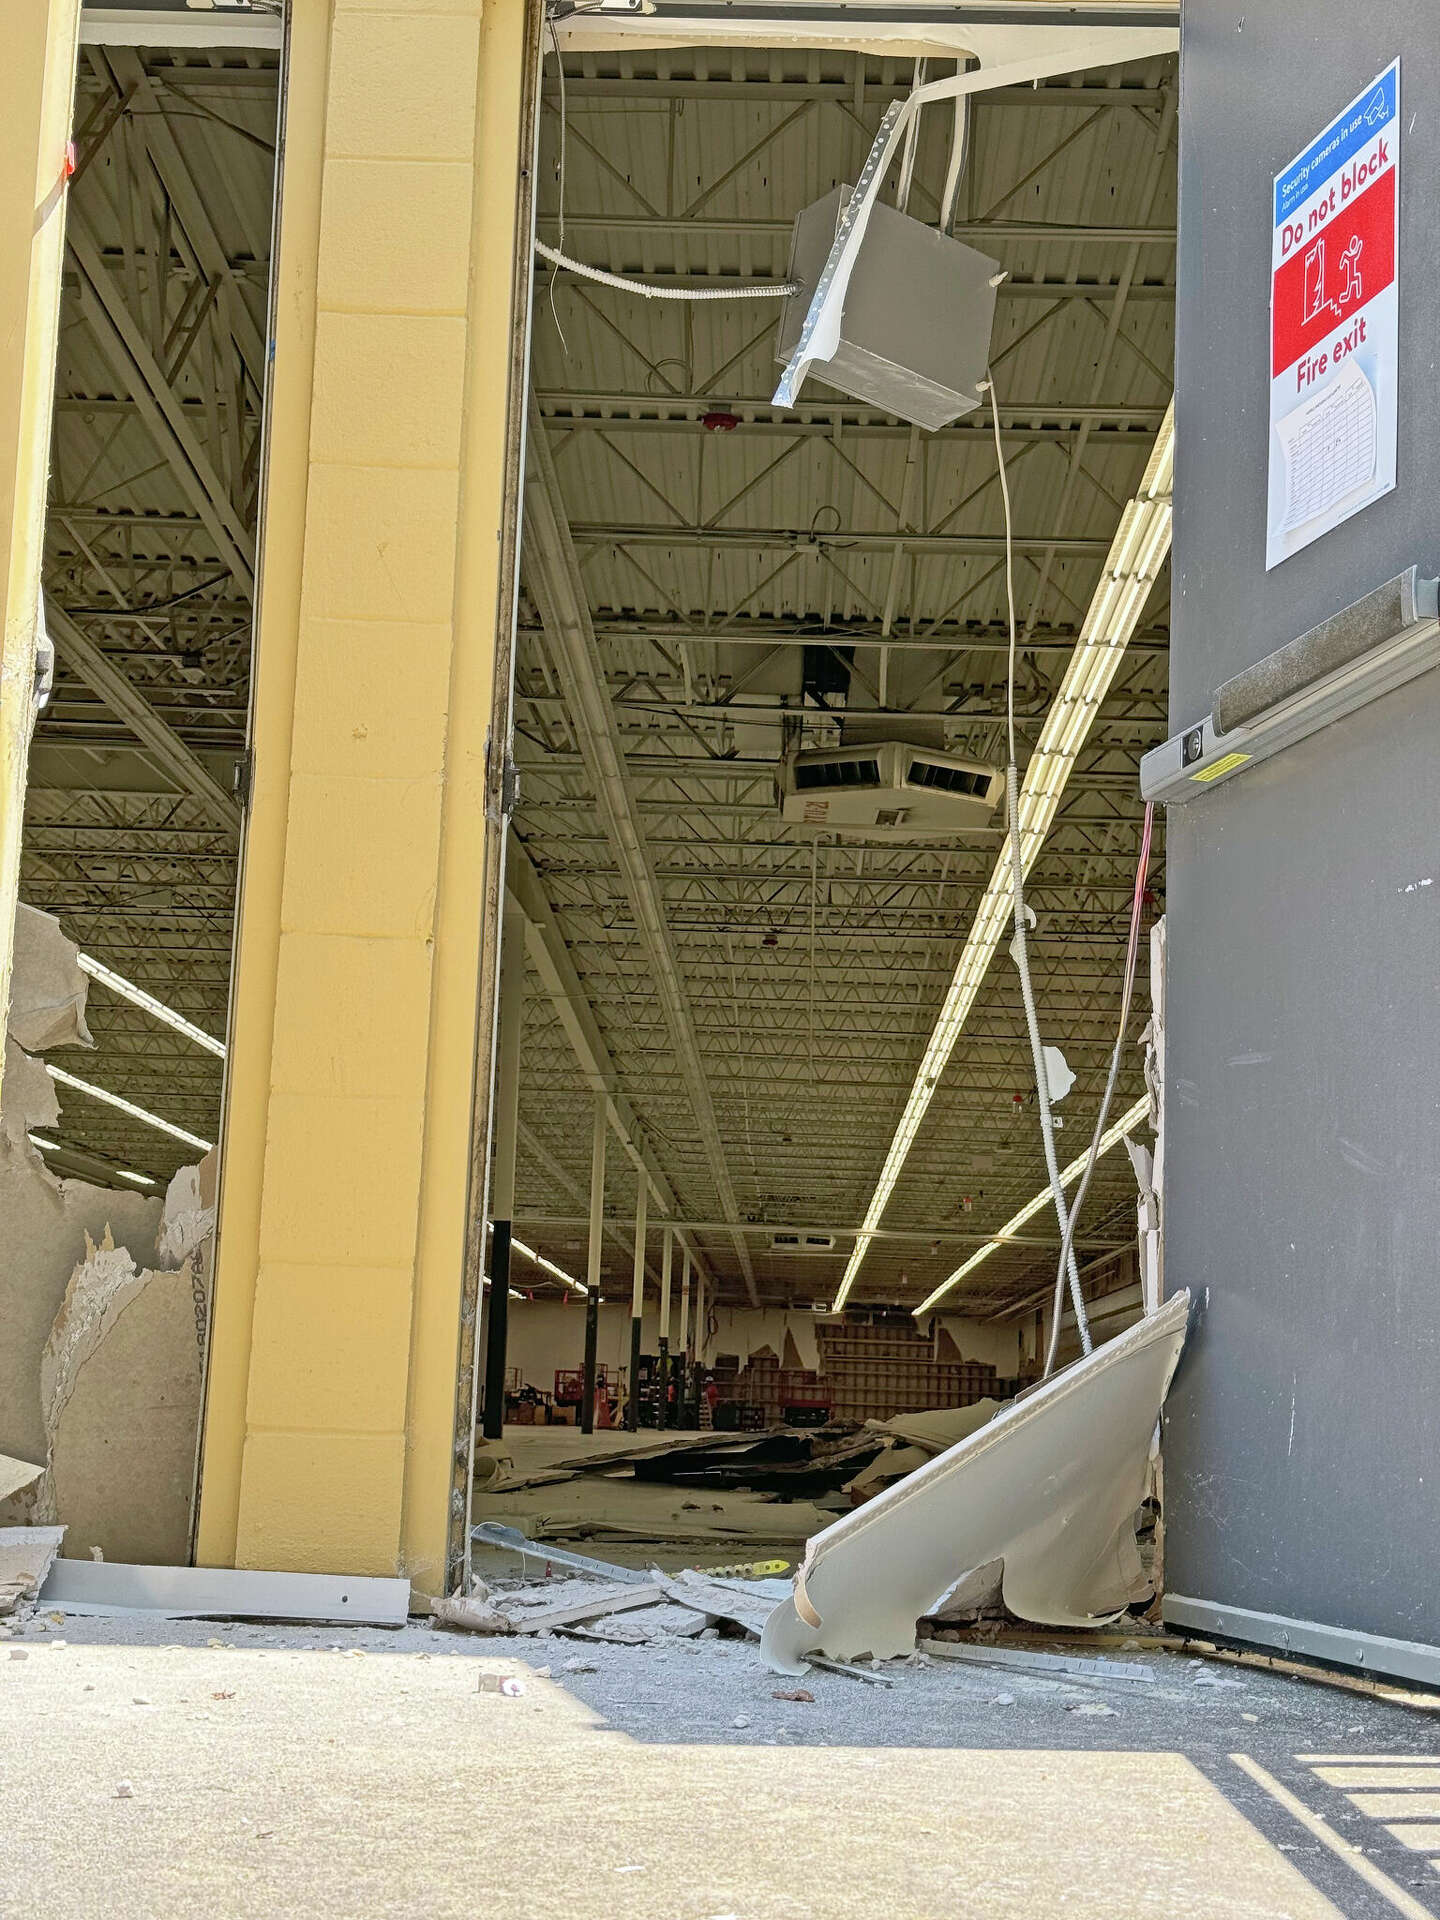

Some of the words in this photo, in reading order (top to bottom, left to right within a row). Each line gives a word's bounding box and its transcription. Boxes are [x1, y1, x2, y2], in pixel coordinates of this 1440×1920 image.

[1281, 222, 1304, 257] Do
[1308, 186, 1336, 233] not
[1341, 137, 1389, 203] block
[1282, 164, 1310, 198] Security
[1311, 136, 1340, 170] cameras
[1340, 128, 1349, 143] in
[1349, 115, 1363, 133] use
[1297, 353, 1328, 394] Fire
[1332, 316, 1367, 363] exit
